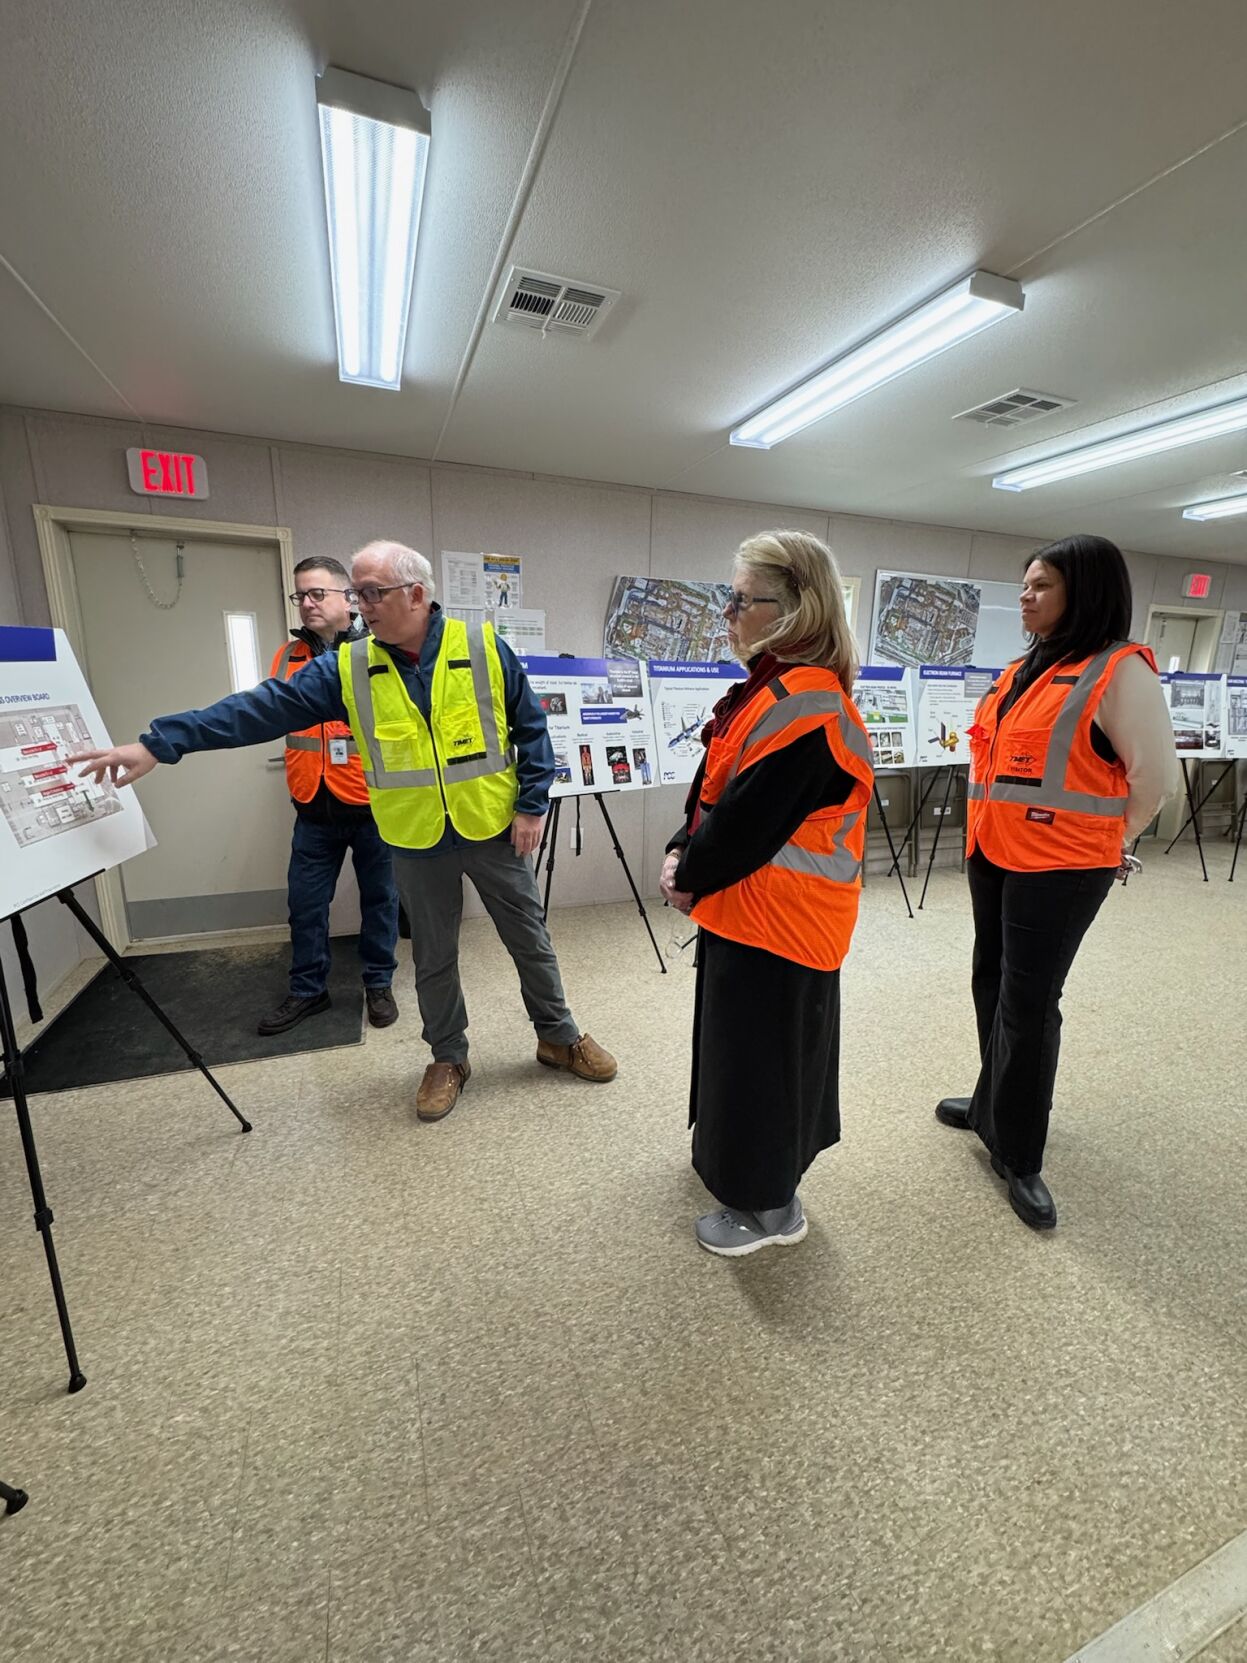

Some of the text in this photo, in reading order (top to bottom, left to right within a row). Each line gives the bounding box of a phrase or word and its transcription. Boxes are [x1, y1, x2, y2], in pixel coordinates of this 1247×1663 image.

[141, 451, 195, 495] EXIT
[4, 695, 32, 704] OVERVIEW
[32, 693, 51, 701] BOARD
